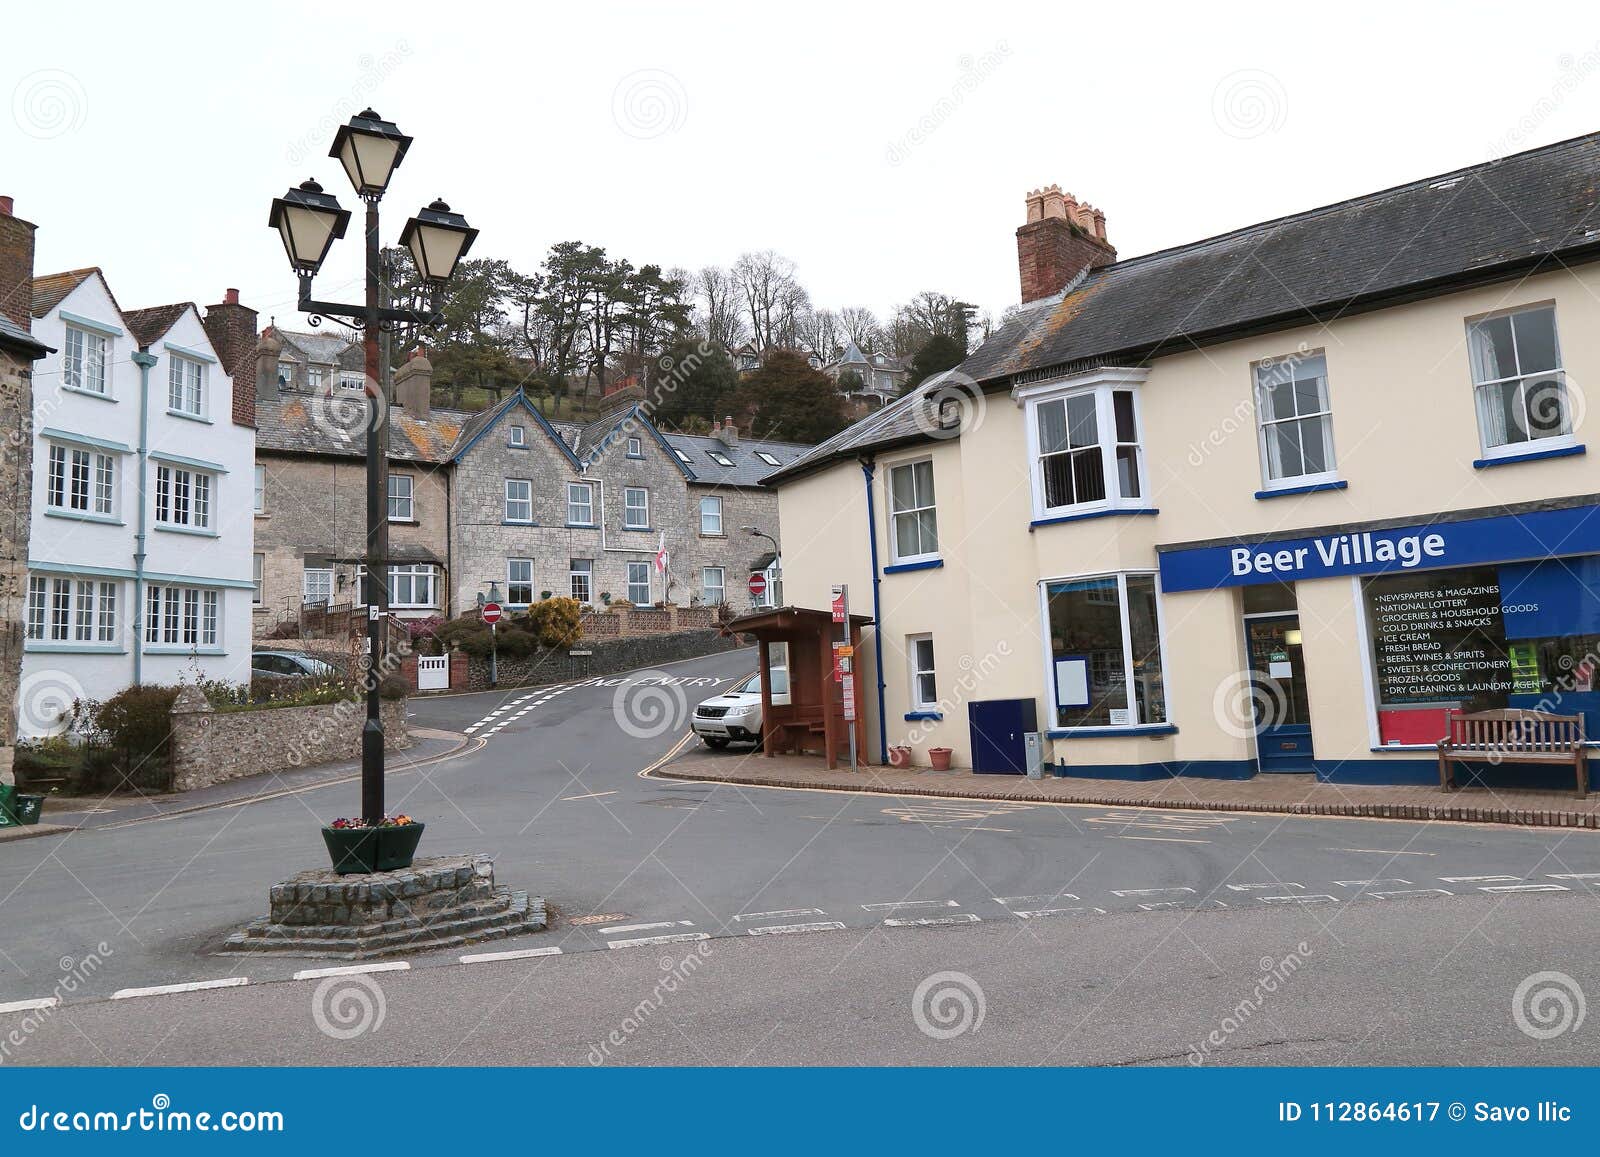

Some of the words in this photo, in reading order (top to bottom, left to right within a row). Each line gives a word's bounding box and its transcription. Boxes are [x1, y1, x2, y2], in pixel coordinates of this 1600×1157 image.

[1230, 547, 1306, 577] Beer
[1313, 531, 1446, 568] Village
[1379, 591, 1434, 602] NEWSPAPERS
[1437, 590, 1443, 598] &
[1445, 585, 1499, 597] MAGAZINES
[1380, 602, 1427, 612] NATIONAL
[1428, 599, 1467, 609] LOTTERY
[1381, 612, 1429, 622] GROCERIES
[1431, 611, 1438, 619] &
[1440, 607, 1499, 618] HOUSEHOLD
[1501, 604, 1539, 614] GOODS
[1382, 624, 1408, 633] COLD
[1410, 621, 1444, 631] DRINKS
[1446, 620, 1452, 628] &
[1454, 618, 1491, 628] SNACKS
[1383, 635, 1397, 643] ICE
[1400, 632, 1430, 642] CREAM
[1385, 644, 1410, 653] FRESH
[1412, 642, 1441, 651] BREAD
[1413, 652, 1443, 661] WINES
[1445, 652, 1452, 660] &
[1453, 650, 1485, 659] SPIRITS
[1387, 665, 1420, 674] SWEETS
[1422, 664, 1429, 672] &
[1431, 660, 1510, 672] CONFECTIONERY
[584, 678, 631, 687] NO
[631, 676, 735, 687] ENTRY
[1388, 675, 1424, 684] FROZEN
[1425, 673, 1461, 683] GOODS
[1389, 686, 1406, 695] DRY
[1409, 683, 1456, 693] CLEANING
[1458, 683, 1465, 691] &
[1467, 681, 1512, 691] LAUNDRY
